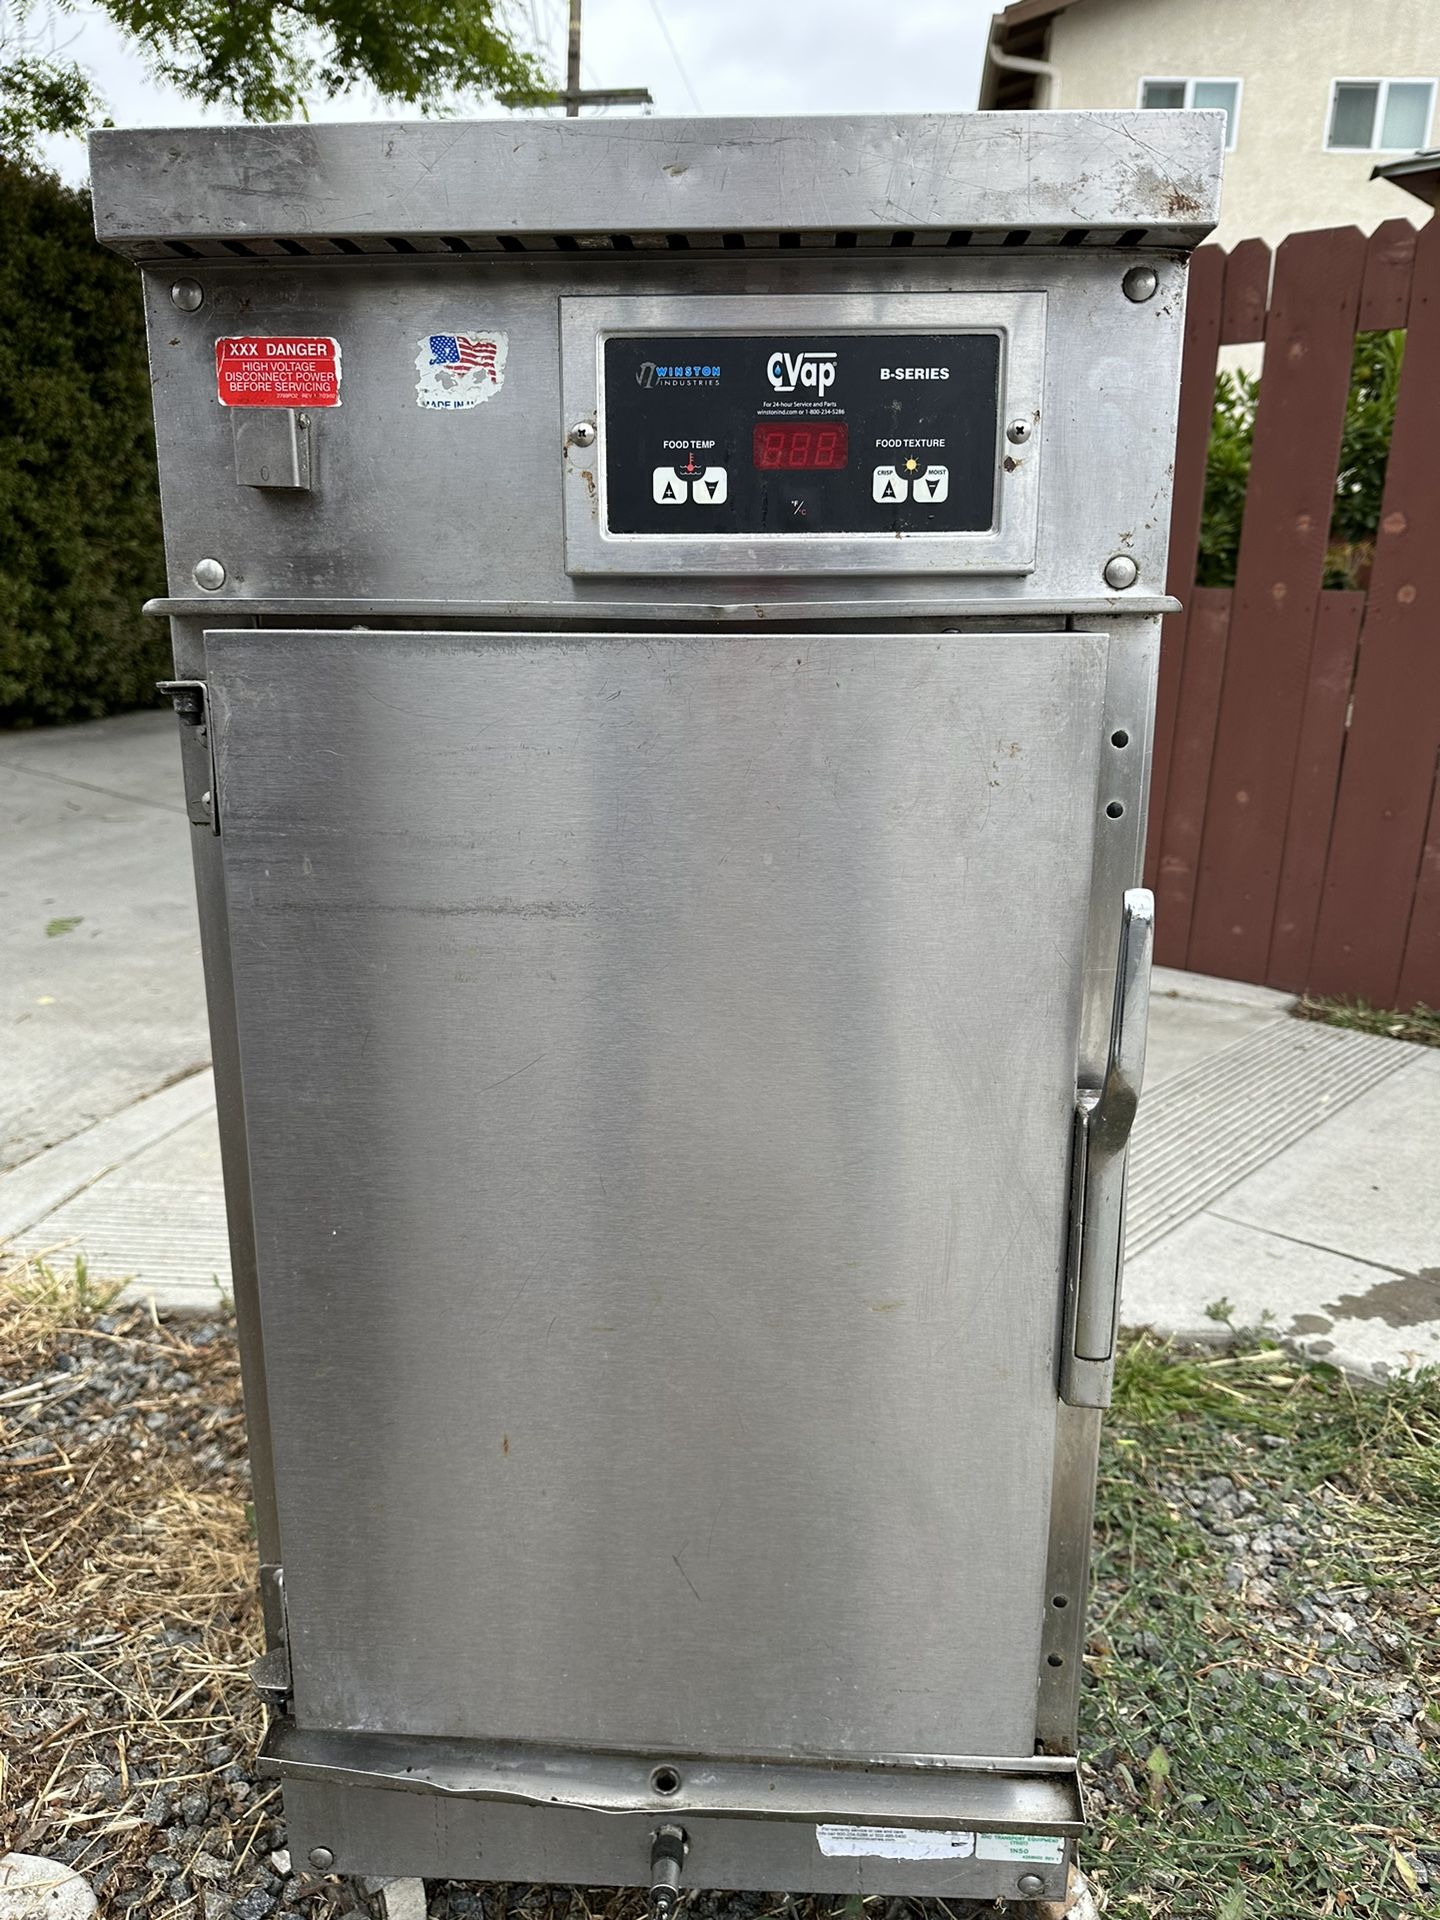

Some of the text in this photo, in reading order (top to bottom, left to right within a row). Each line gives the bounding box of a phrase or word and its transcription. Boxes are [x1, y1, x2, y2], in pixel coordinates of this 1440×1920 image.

[230, 343, 327, 356] XXX DANGER
[242, 361, 316, 371] HIGH VOLTAGE
[225, 372, 335, 381] DISCONNECT POWER
[656, 366, 720, 377] WINSTON
[880, 368, 950, 380] B-SERIES
[230, 382, 331, 392] BEFORE SERVICING
[663, 440, 715, 449] FOOD TEMP
[875, 439, 946, 448] FOOD TEXTURE
